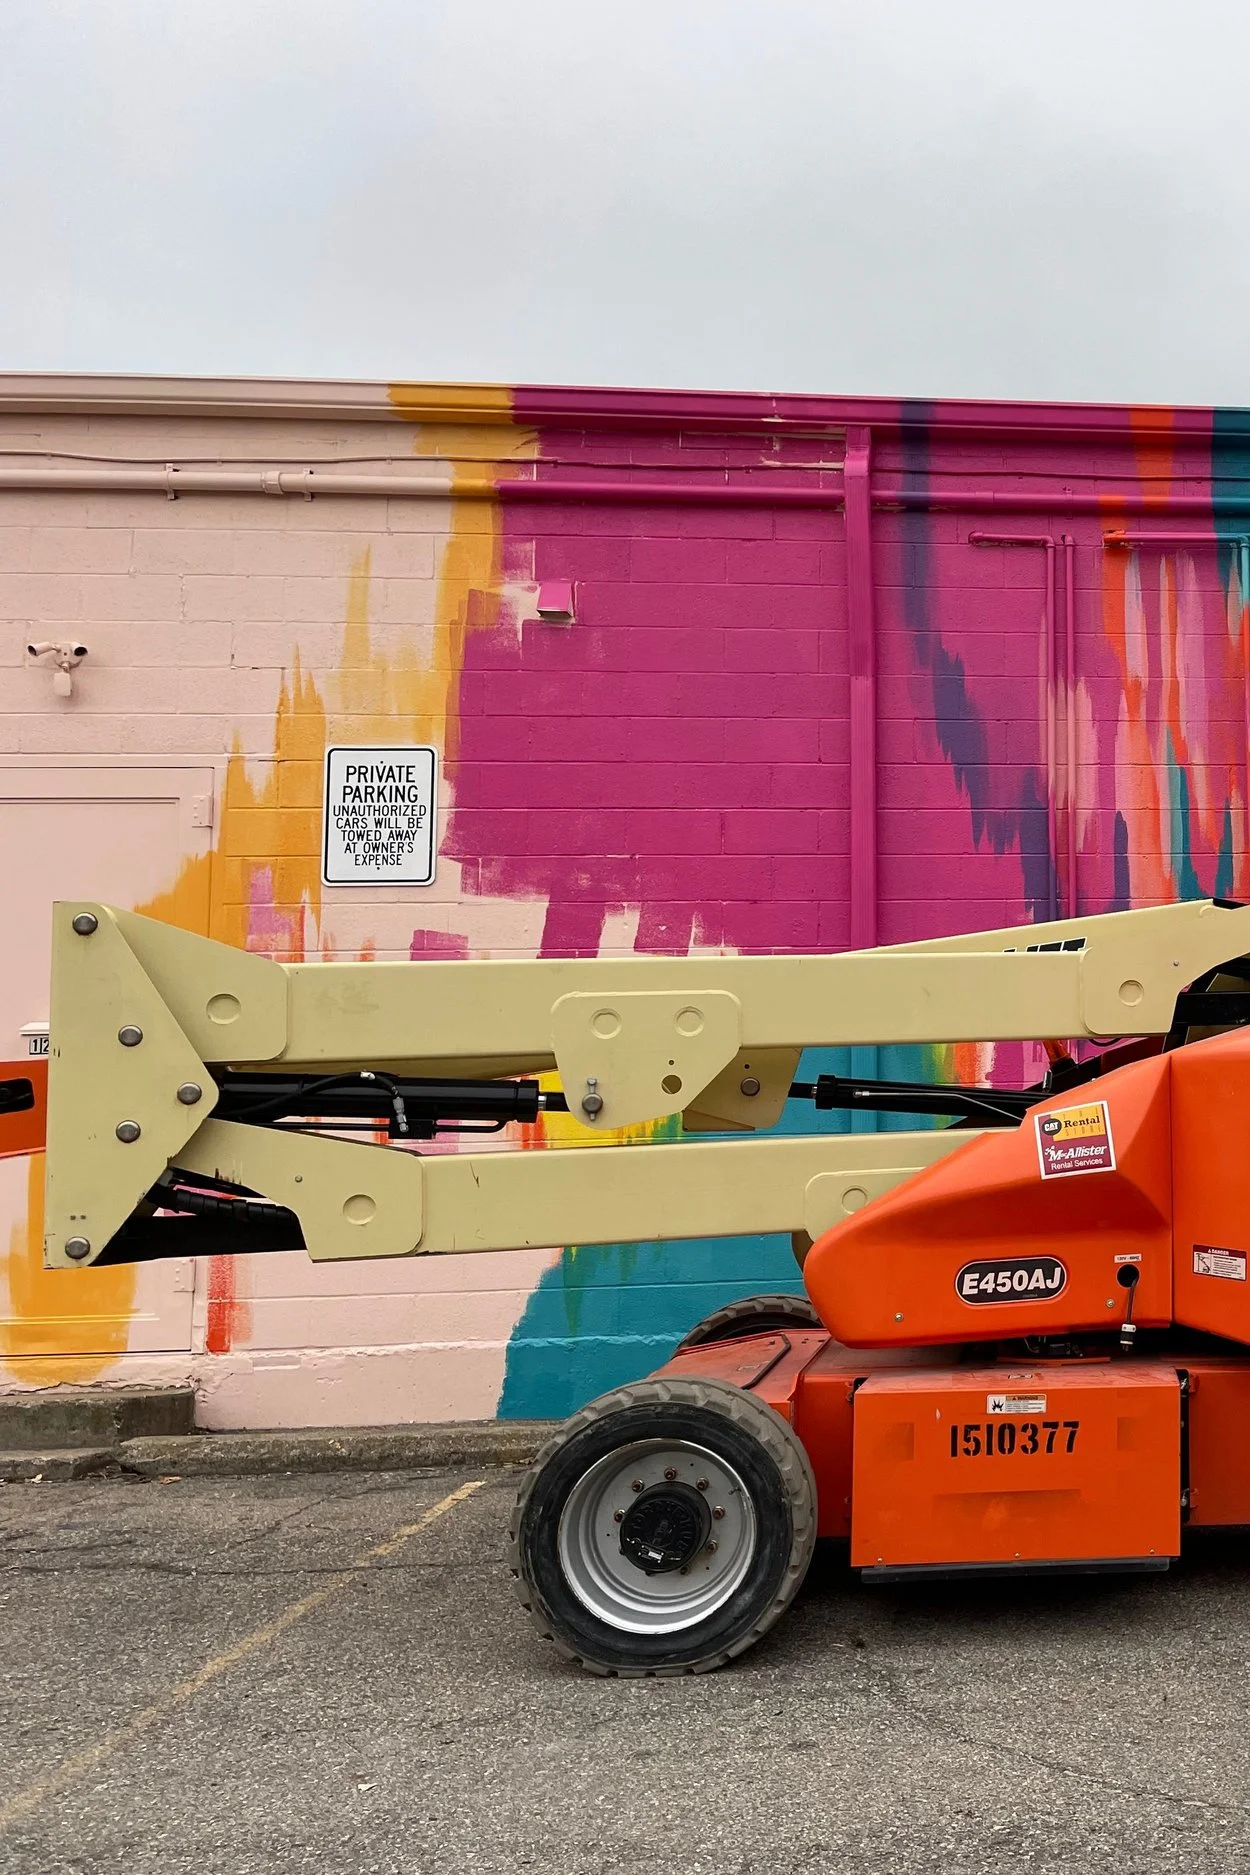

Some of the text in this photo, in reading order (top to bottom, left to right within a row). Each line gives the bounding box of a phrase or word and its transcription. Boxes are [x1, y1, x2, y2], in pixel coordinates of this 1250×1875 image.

[346, 765, 416, 783] PRIVATE
[342, 785, 418, 803] PARKING
[333, 805, 427, 817] UNAUTHORIZED
[336, 817, 423, 829] CARS WILL BE
[341, 830, 418, 841] TOWED AWAY
[344, 842, 414, 854] AT OWNER'S
[354, 854, 403, 866] EXPENSE
[1044, 1122, 1058, 1131] CAT
[1064, 1115, 1100, 1128] Rental
[1051, 1159, 1103, 1170] Rental Services
[962, 1267, 1062, 1295] E450AJ
[951, 1421, 1080, 1457] 1510377
